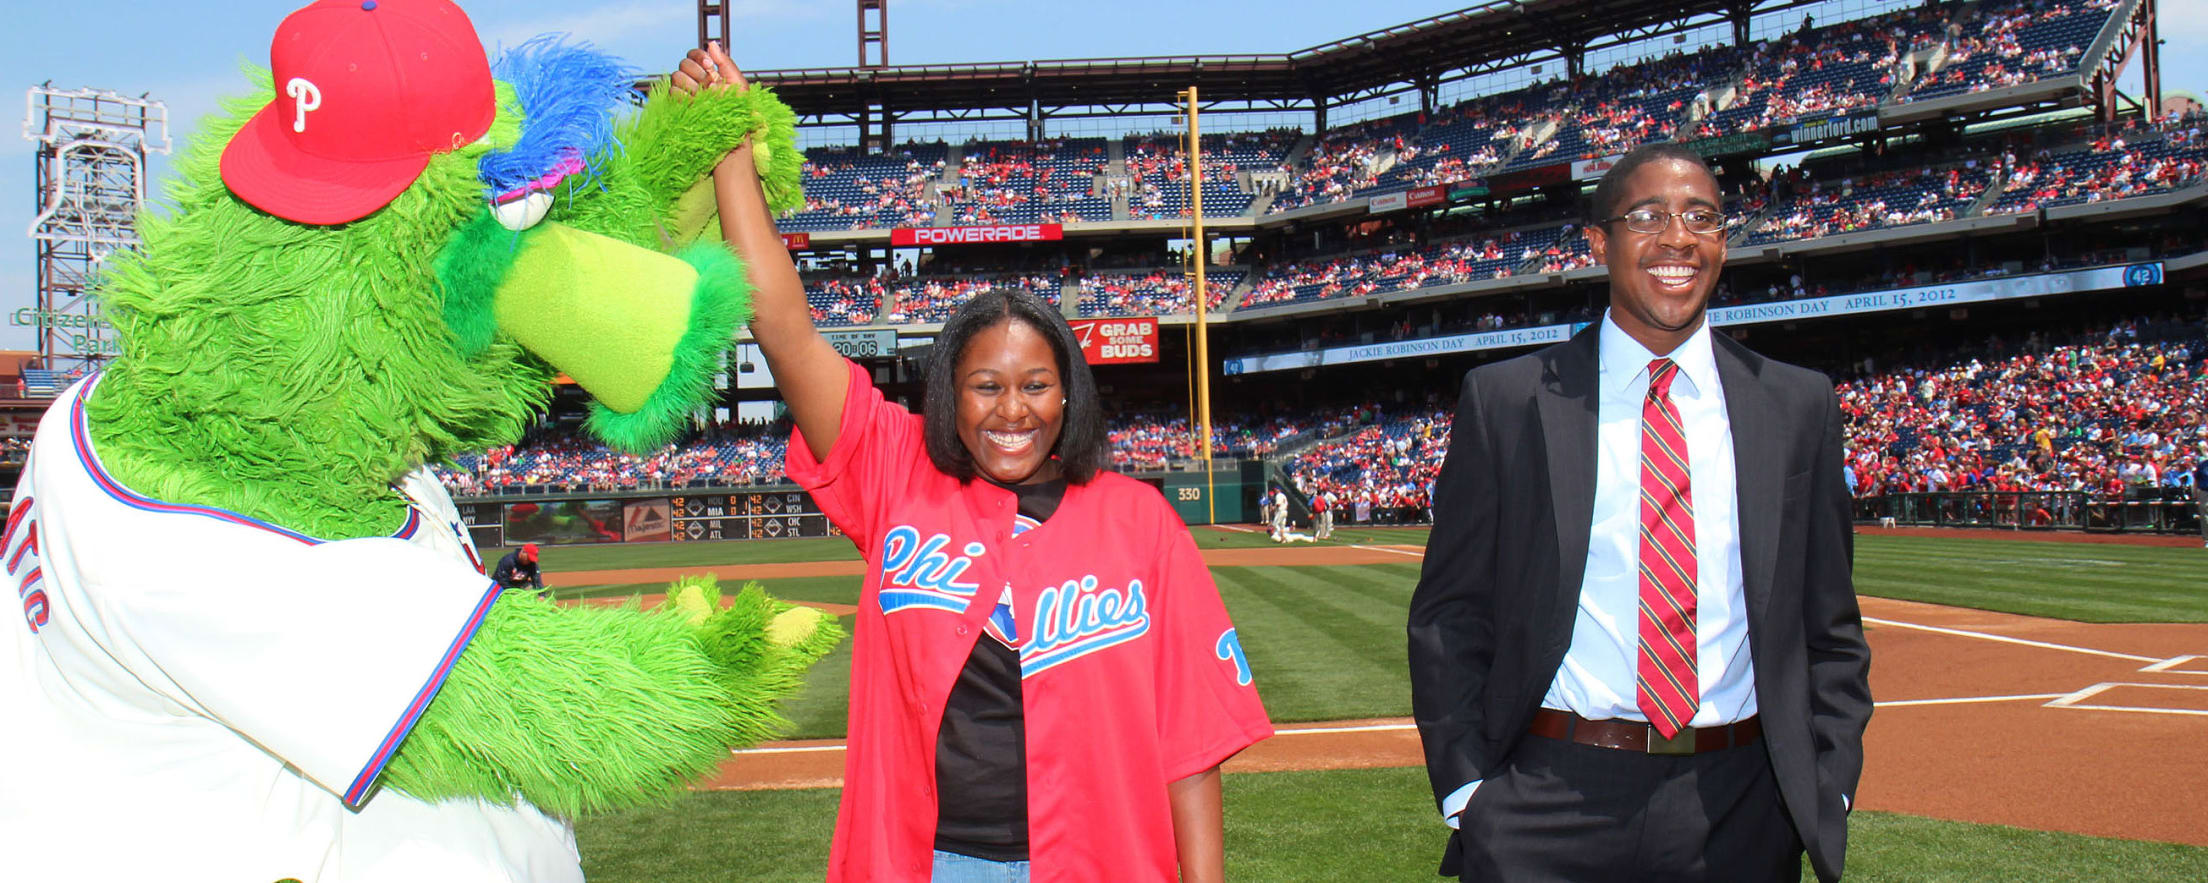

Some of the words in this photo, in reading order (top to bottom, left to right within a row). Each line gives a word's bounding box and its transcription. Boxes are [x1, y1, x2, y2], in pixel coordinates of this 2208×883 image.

[286, 77, 322, 132] P
[1790, 115, 1878, 144] winnerford.com
[1408, 189, 1435, 200] Canon
[914, 225, 1042, 244] POWERADE
[2132, 269, 2150, 284] 42
[1725, 304, 1795, 321] ROBINSON
[1799, 300, 1830, 314] DAY
[1844, 294, 1887, 310] APRIL
[1892, 292, 1913, 308] 15,
[1919, 288, 1956, 302] 2012
[1099, 322, 1153, 337] GRAB
[1109, 335, 1145, 345] SOME
[1348, 345, 1384, 361] JACKIE
[1385, 340, 1439, 355] ROBINSON
[1441, 337, 1464, 350] DAY
[1474, 334, 1507, 347] APRIL
[1511, 333, 1527, 345] 15,
[1530, 328, 1559, 341] 2012
[1101, 343, 1153, 359] BUDS
[1178, 487, 1201, 501] 330
[707, 507, 724, 517] MIA
[786, 504, 802, 514] WSH
[787, 528, 801, 537] STL
